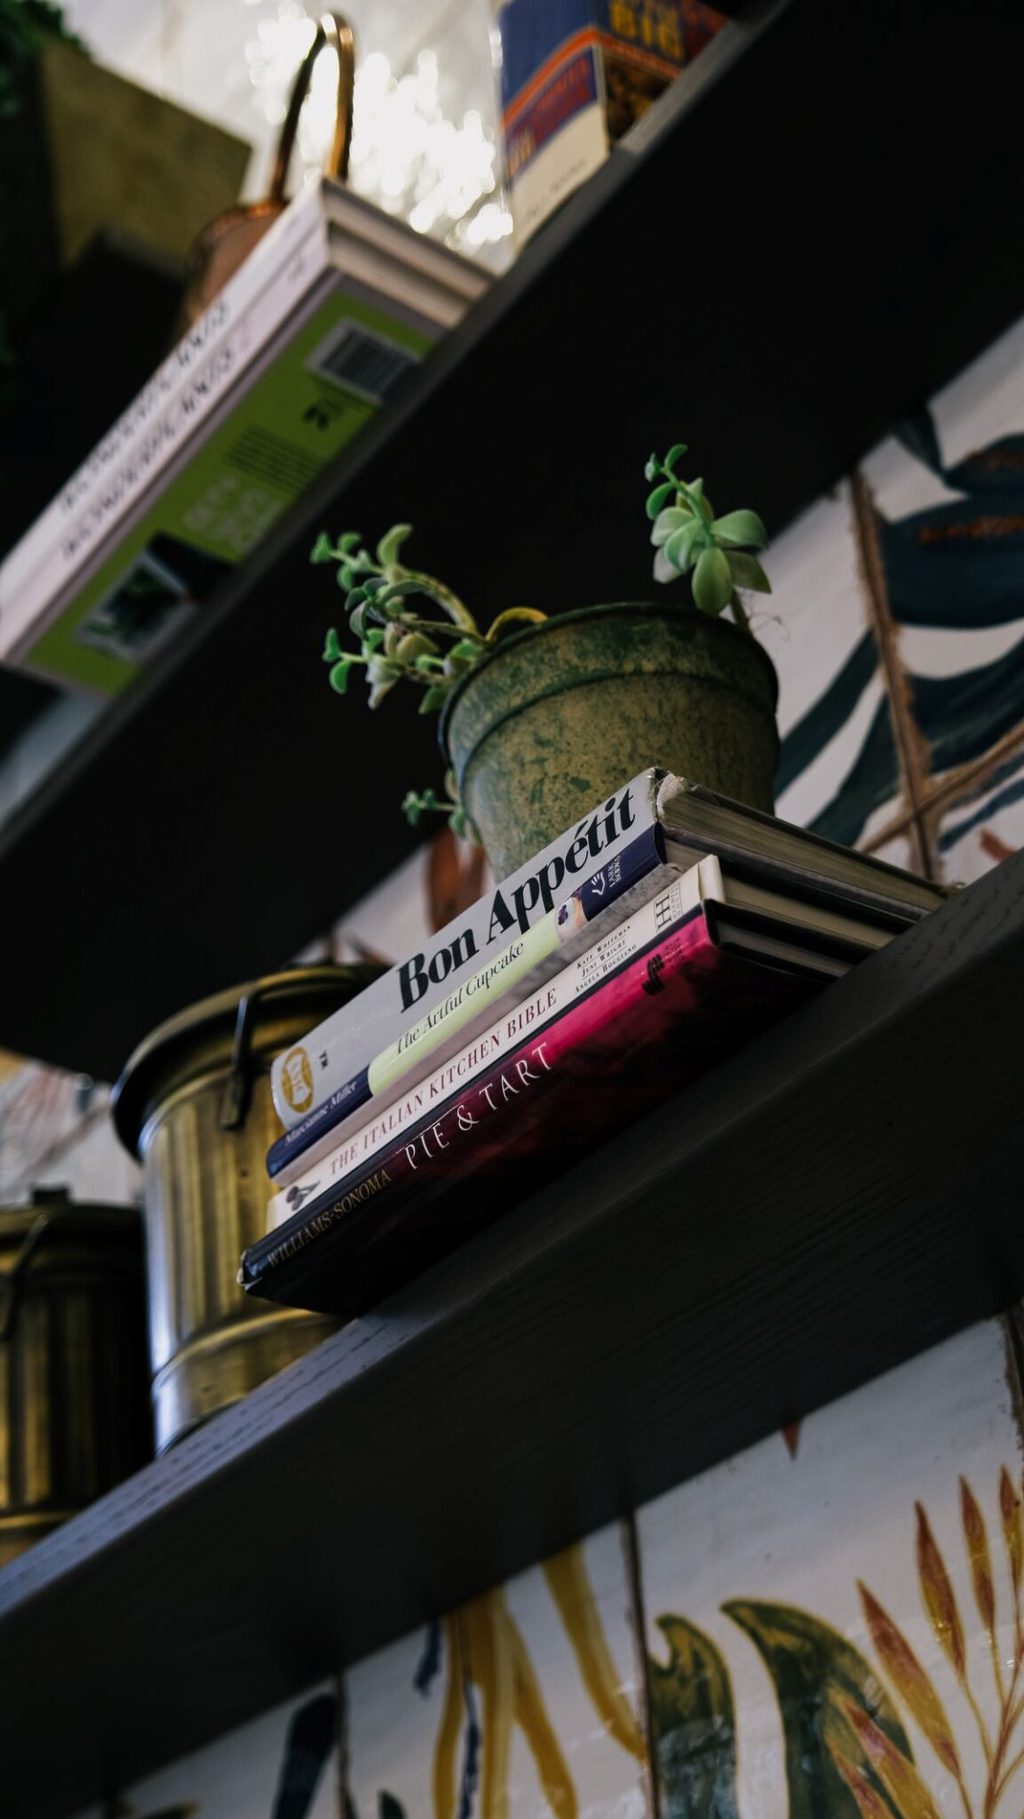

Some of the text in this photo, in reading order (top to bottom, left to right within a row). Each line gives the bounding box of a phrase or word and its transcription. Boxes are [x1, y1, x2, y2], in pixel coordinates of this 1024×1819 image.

[397, 788, 636, 1013] Bon Appétit
[396, 942, 524, 1055] The Artful Cupcake
[330, 987, 557, 1175] THE ITALIAN KITCHEN BIBLE
[404, 1041, 553, 1171] PIE & TART
[266, 1168, 392, 1267] WILLIAMS-SONOMA
